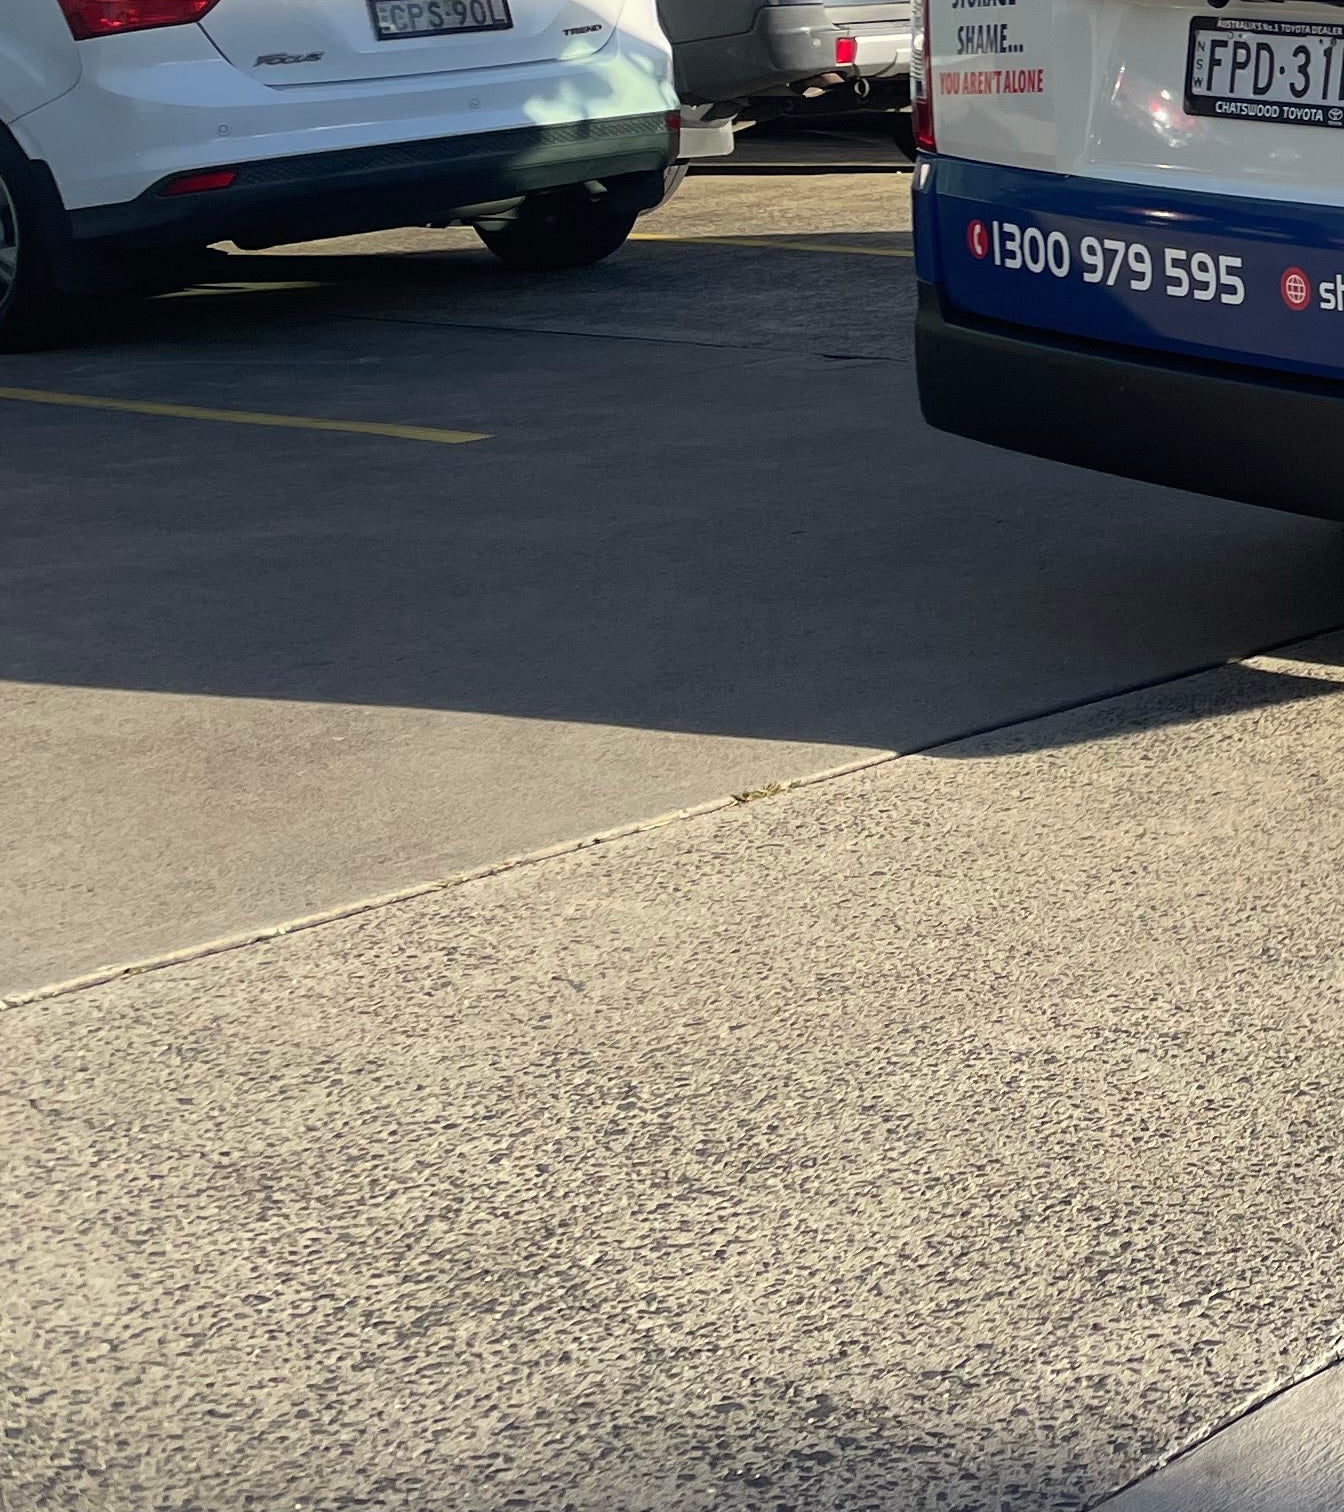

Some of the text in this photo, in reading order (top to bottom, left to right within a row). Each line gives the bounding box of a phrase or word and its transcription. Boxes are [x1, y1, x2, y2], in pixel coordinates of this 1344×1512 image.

[957, 24, 1024, 55] SHAME...
[1217, 17, 1262, 31] AUSTRALIA'S
[1281, 24, 1310, 34] TOYOTA
[1311, 24, 1343, 36] DEALER
[939, 69, 1044, 95] YOU AREN'T ALONE
[1215, 101, 1324, 122] CHATSWOOD TOYOTA
[993, 222, 1245, 305] 1300 979 595
